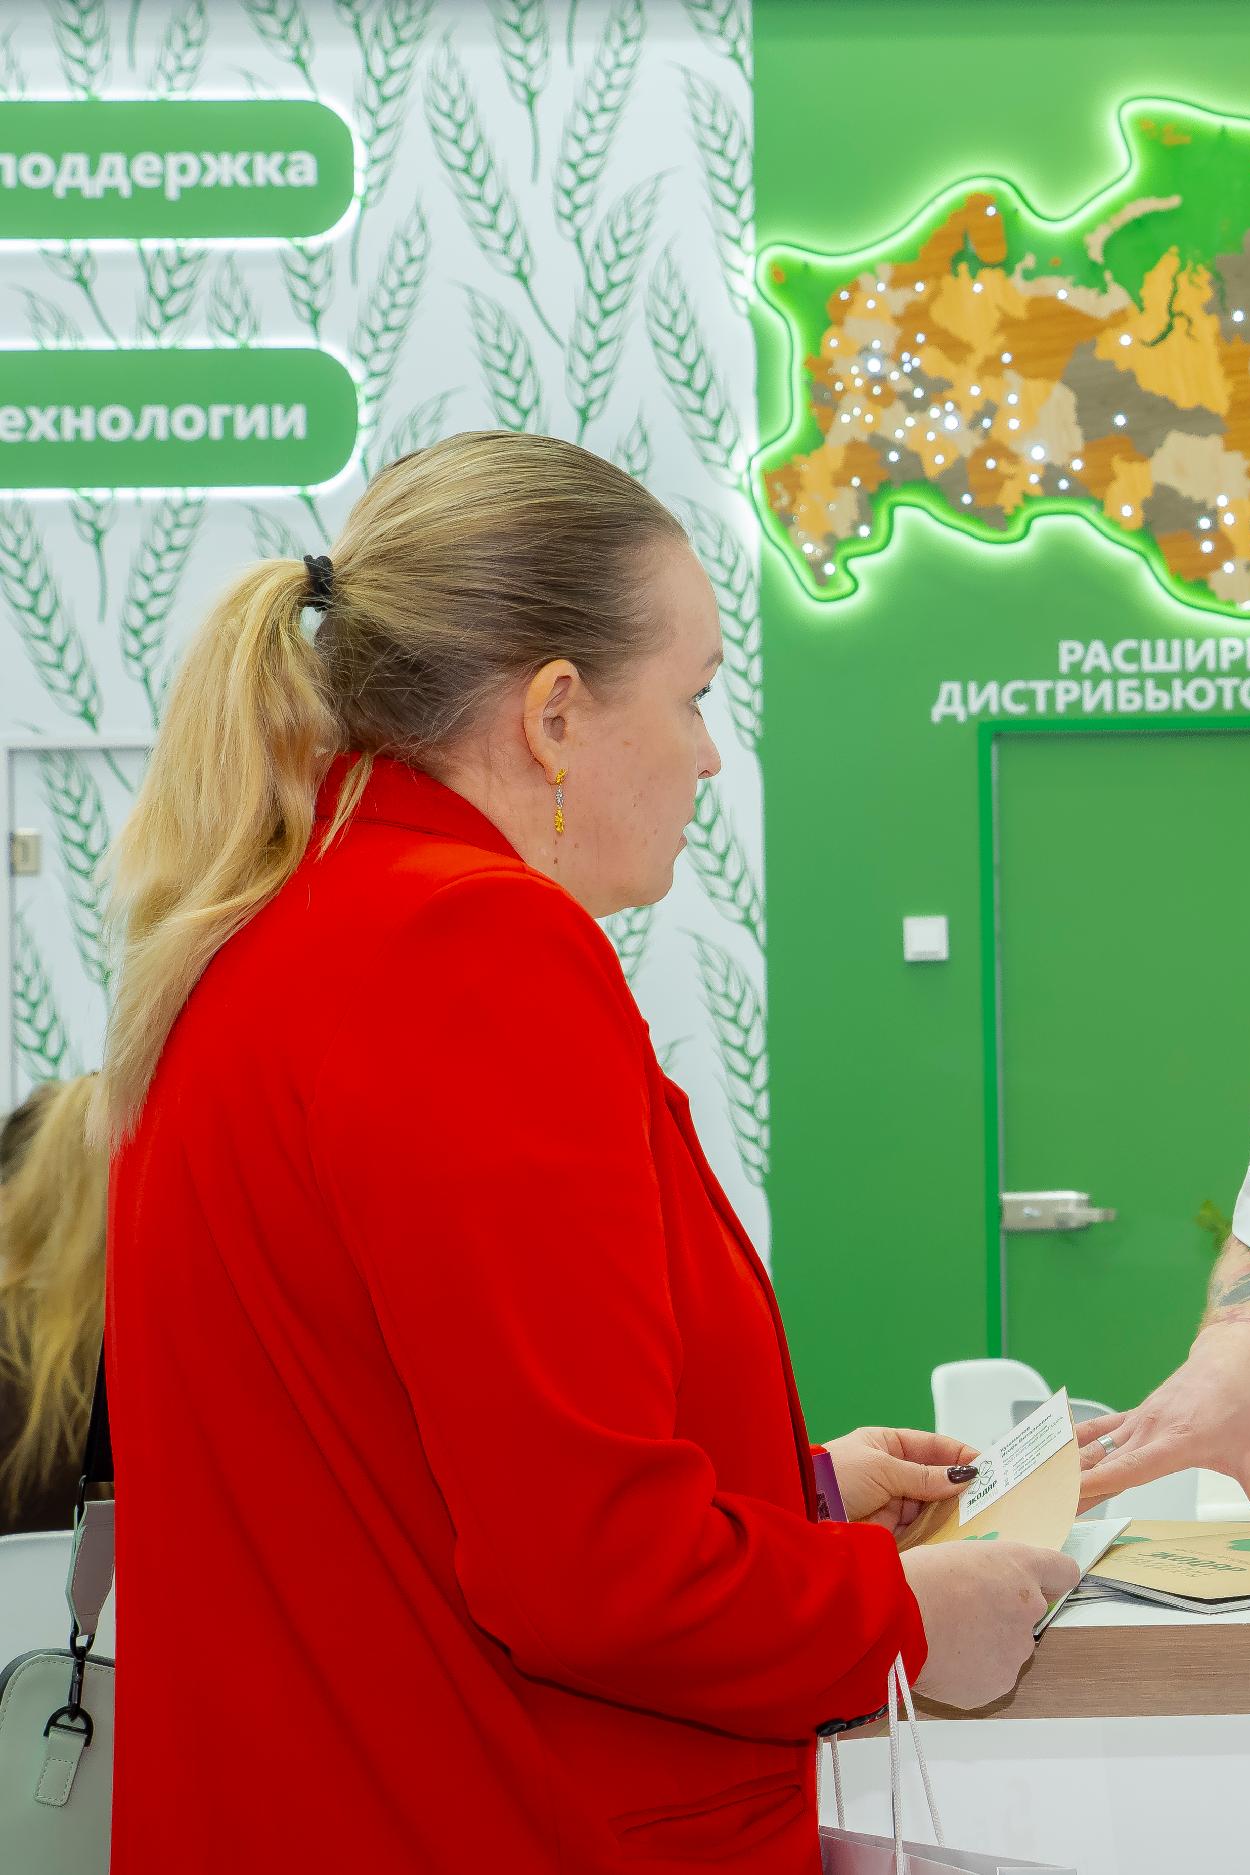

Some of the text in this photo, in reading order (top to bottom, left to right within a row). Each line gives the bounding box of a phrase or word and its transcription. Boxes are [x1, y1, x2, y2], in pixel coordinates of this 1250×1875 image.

[0, 150, 319, 200] поддержка
[0, 403, 307, 441] ехнологии
[967, 1480, 997, 1507] ЭКОДАР
